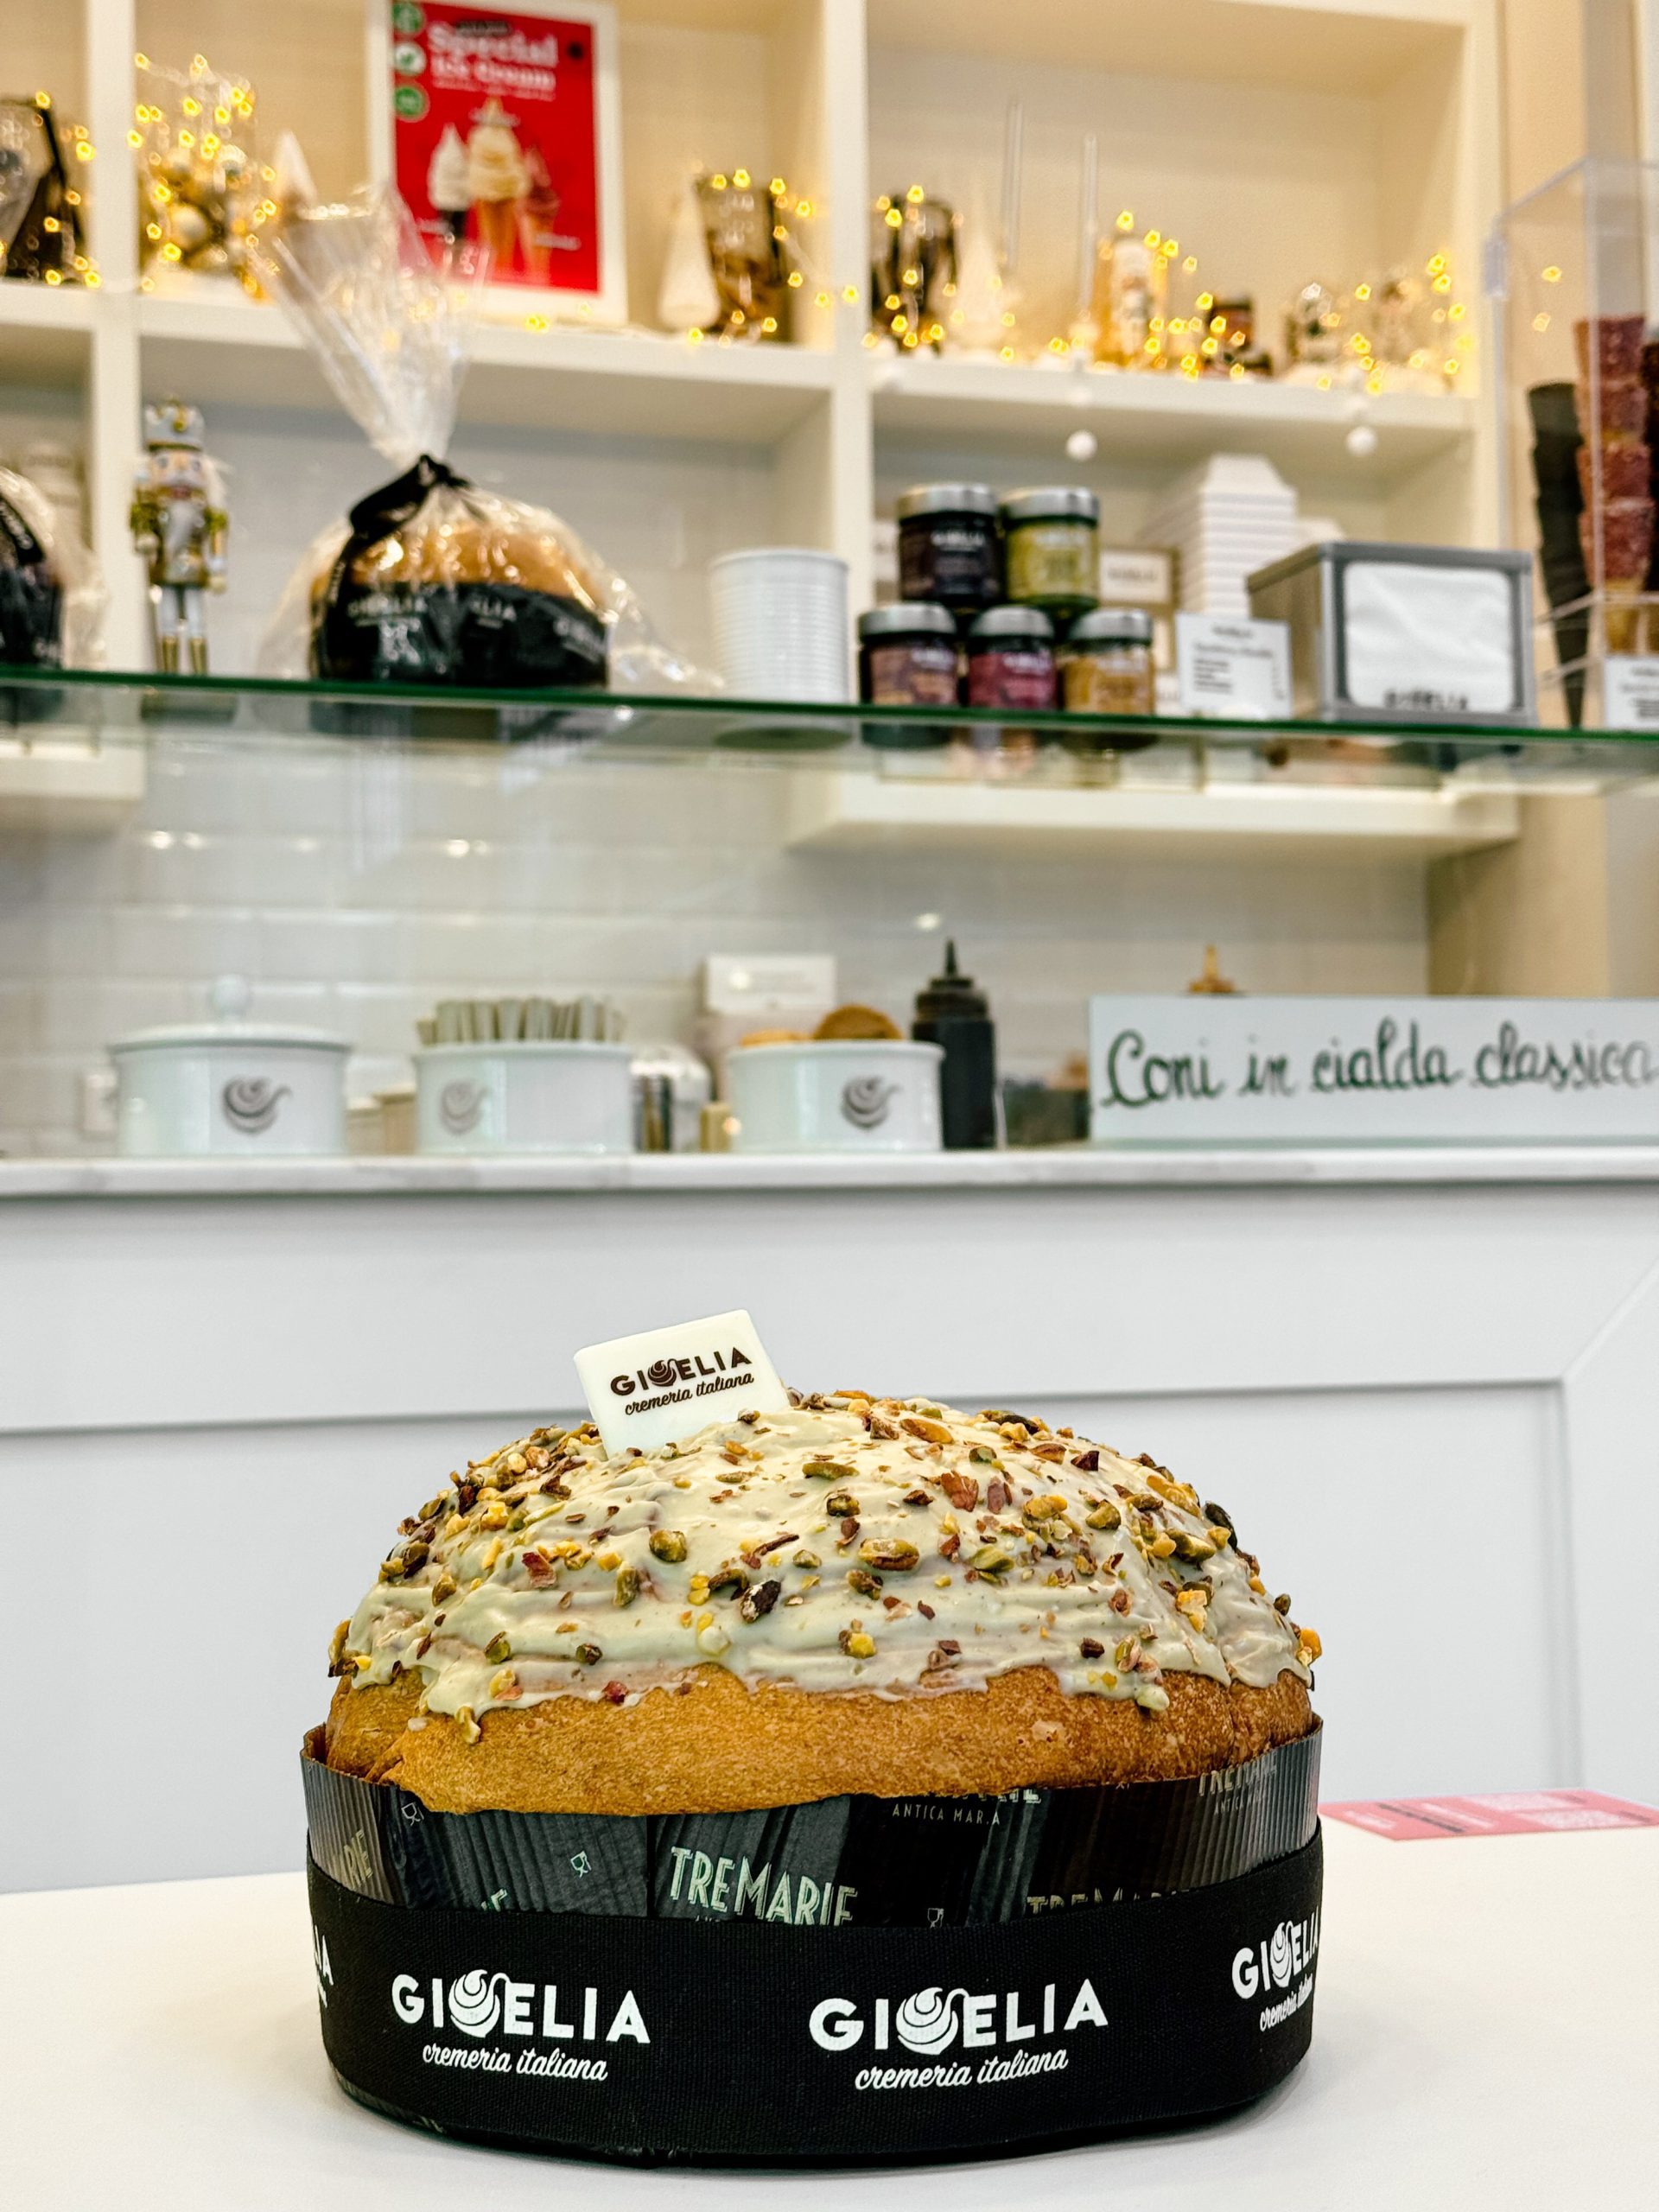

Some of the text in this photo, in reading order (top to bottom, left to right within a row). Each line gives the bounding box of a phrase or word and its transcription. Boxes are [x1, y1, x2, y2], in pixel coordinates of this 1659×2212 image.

[1100, 1015, 1659, 1107] Coni in cialda classica
[610, 1347, 753, 1396] GIOELIA
[625, 1372, 754, 1415] cremeria italiana
[892, 1803, 1000, 1826] ANTICA MARA
[1231, 1904, 1319, 1999] GIOELIA
[391, 1968, 652, 2044] GIOELIA
[809, 1978, 1109, 2056] GIOELIA
[423, 2043, 608, 2082] cremeria italiana
[855, 2049, 1069, 2091] cremeria italiana
